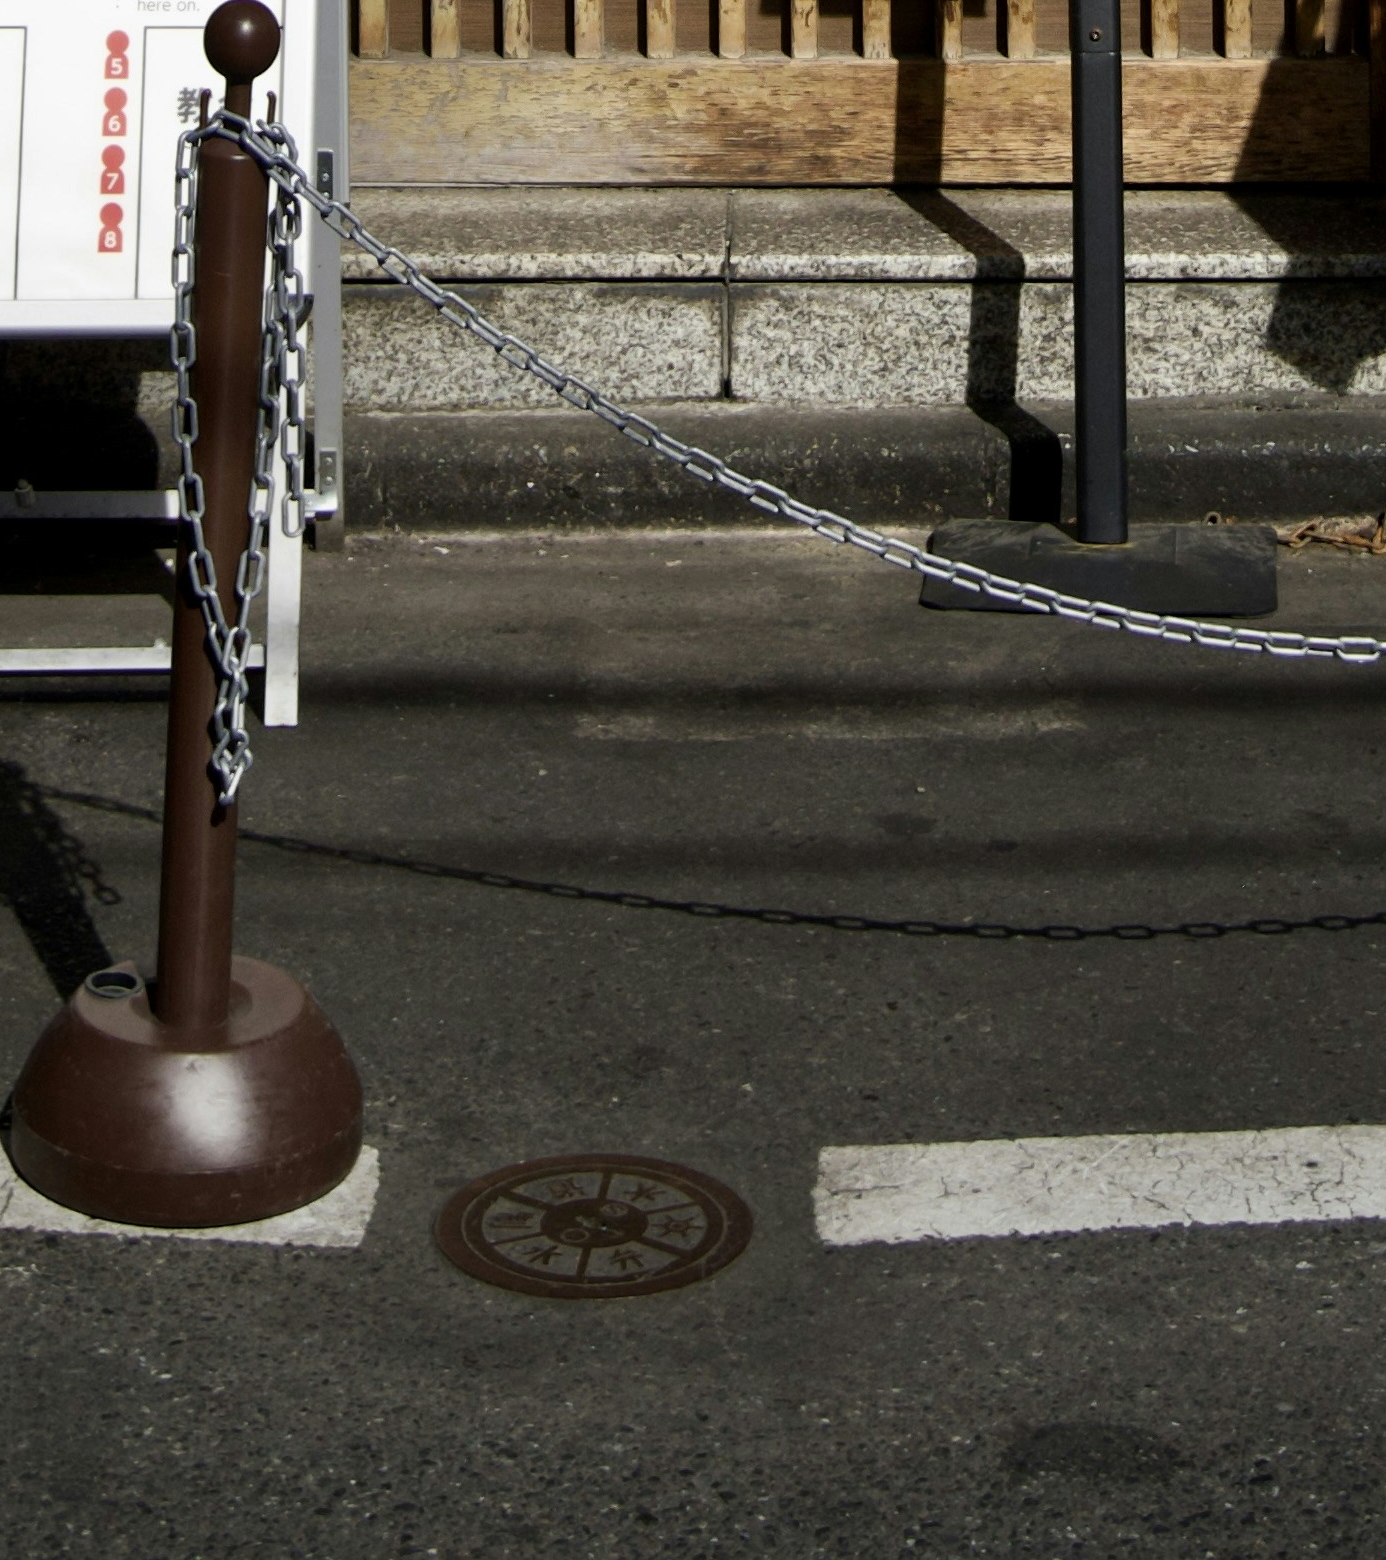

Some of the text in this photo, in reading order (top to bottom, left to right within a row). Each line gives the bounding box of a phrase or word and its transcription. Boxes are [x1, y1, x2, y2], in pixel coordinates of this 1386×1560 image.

[176, 0, 200, 12] on.
[110, 58, 123, 75] 5
[108, 115, 121, 132] 6
[106, 173, 119, 190] 7
[104, 231, 117, 248] 8
